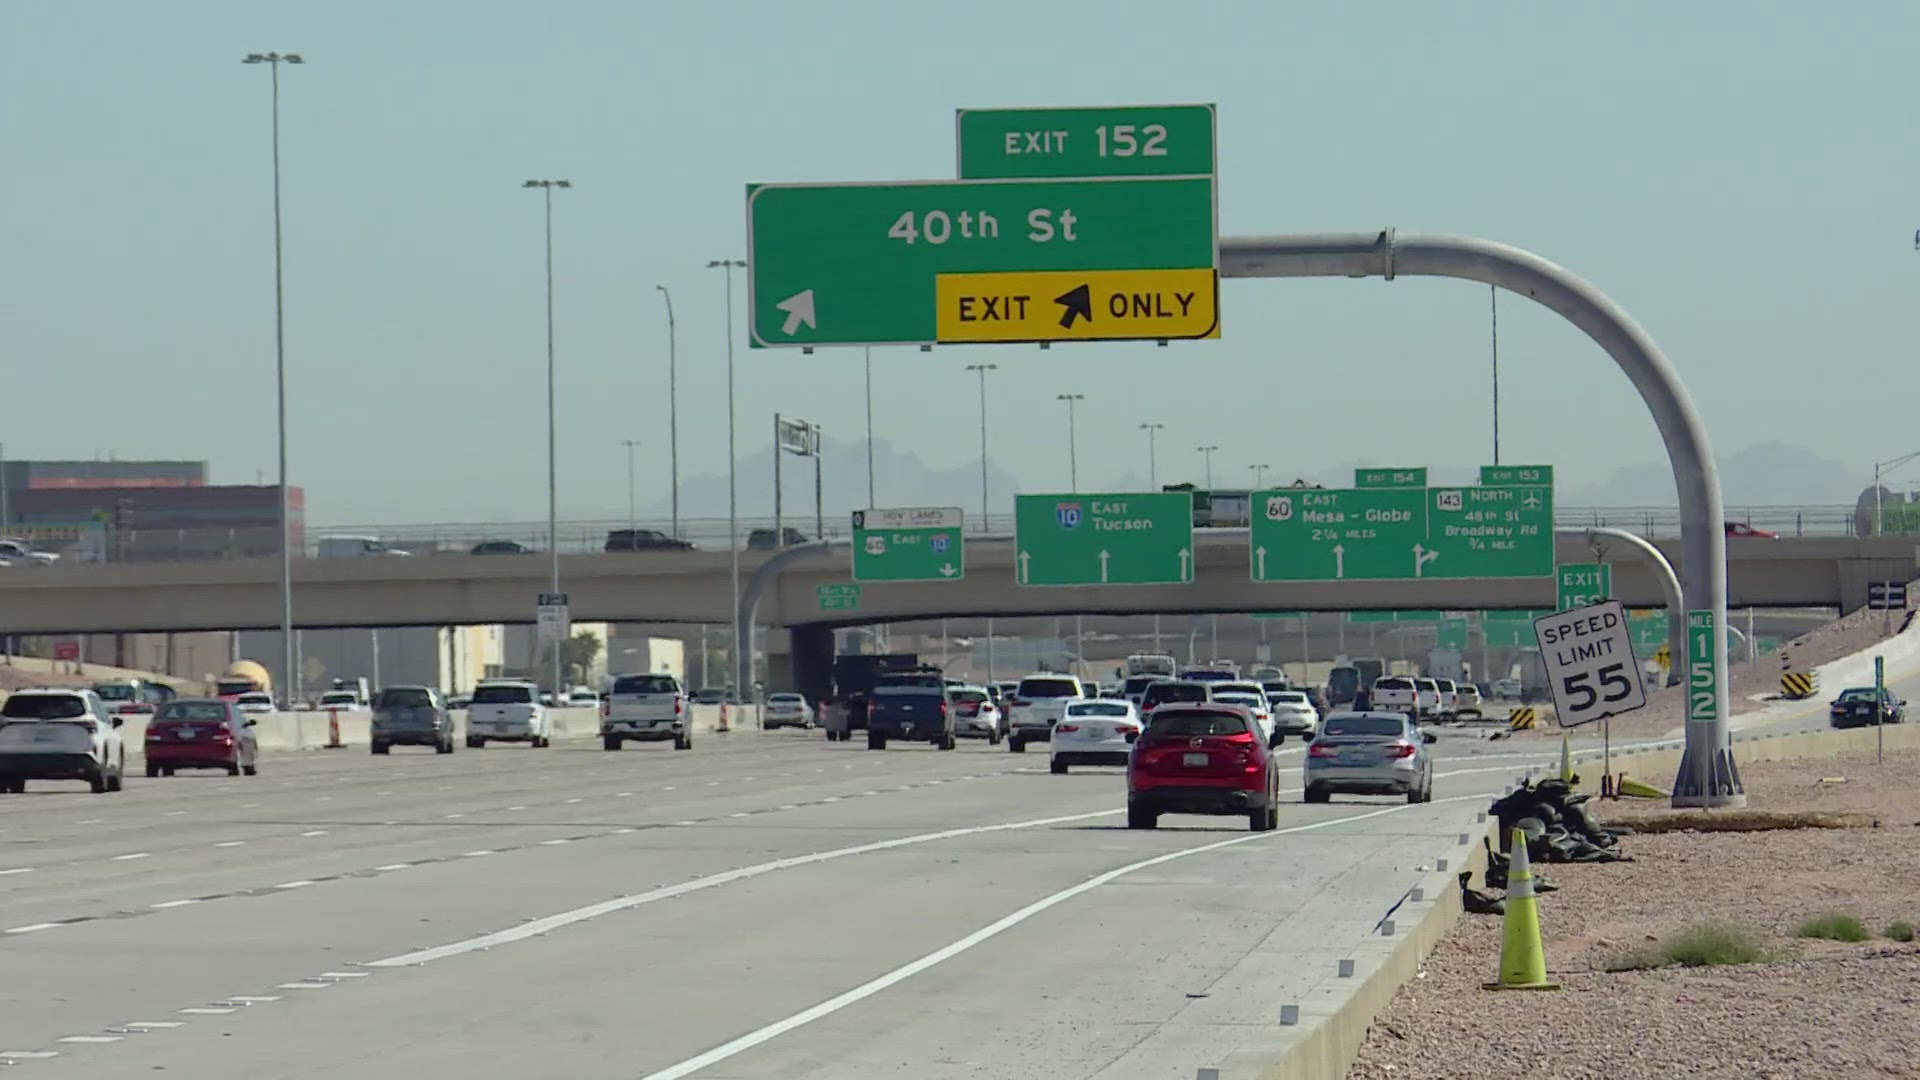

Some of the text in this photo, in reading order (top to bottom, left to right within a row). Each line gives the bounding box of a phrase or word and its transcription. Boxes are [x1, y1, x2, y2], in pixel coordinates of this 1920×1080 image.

[1005, 124, 1168, 157] EXIT 152
[888, 208, 1077, 245] 40th St
[959, 292, 1195, 322] EXIT ONLY
[1393, 472, 1415, 482] 154
[1518, 470, 1540, 480] 153
[1302, 494, 1338, 506] EAST
[1438, 494, 1461, 507] 143
[1470, 489, 1513, 501] NORTH
[1091, 502, 1128, 515] EAST
[1268, 501, 1290, 517] 60
[1302, 510, 1345, 523] Mesa
[1366, 508, 1412, 523] Globe
[1058, 508, 1079, 524] 10
[1505, 510, 1519, 522] St
[1091, 518, 1153, 531] Tucson
[1445, 524, 1538, 539] Broadway Rd
[1346, 529, 1377, 539] MILES
[1492, 540, 1516, 550] MILE
[1563, 572, 1601, 586] EXIT
[1689, 614, 1713, 628] MILE
[1544, 613, 1618, 644] SPEED
[1557, 638, 1614, 666] LIMIT
[1563, 663, 1632, 712] 55
